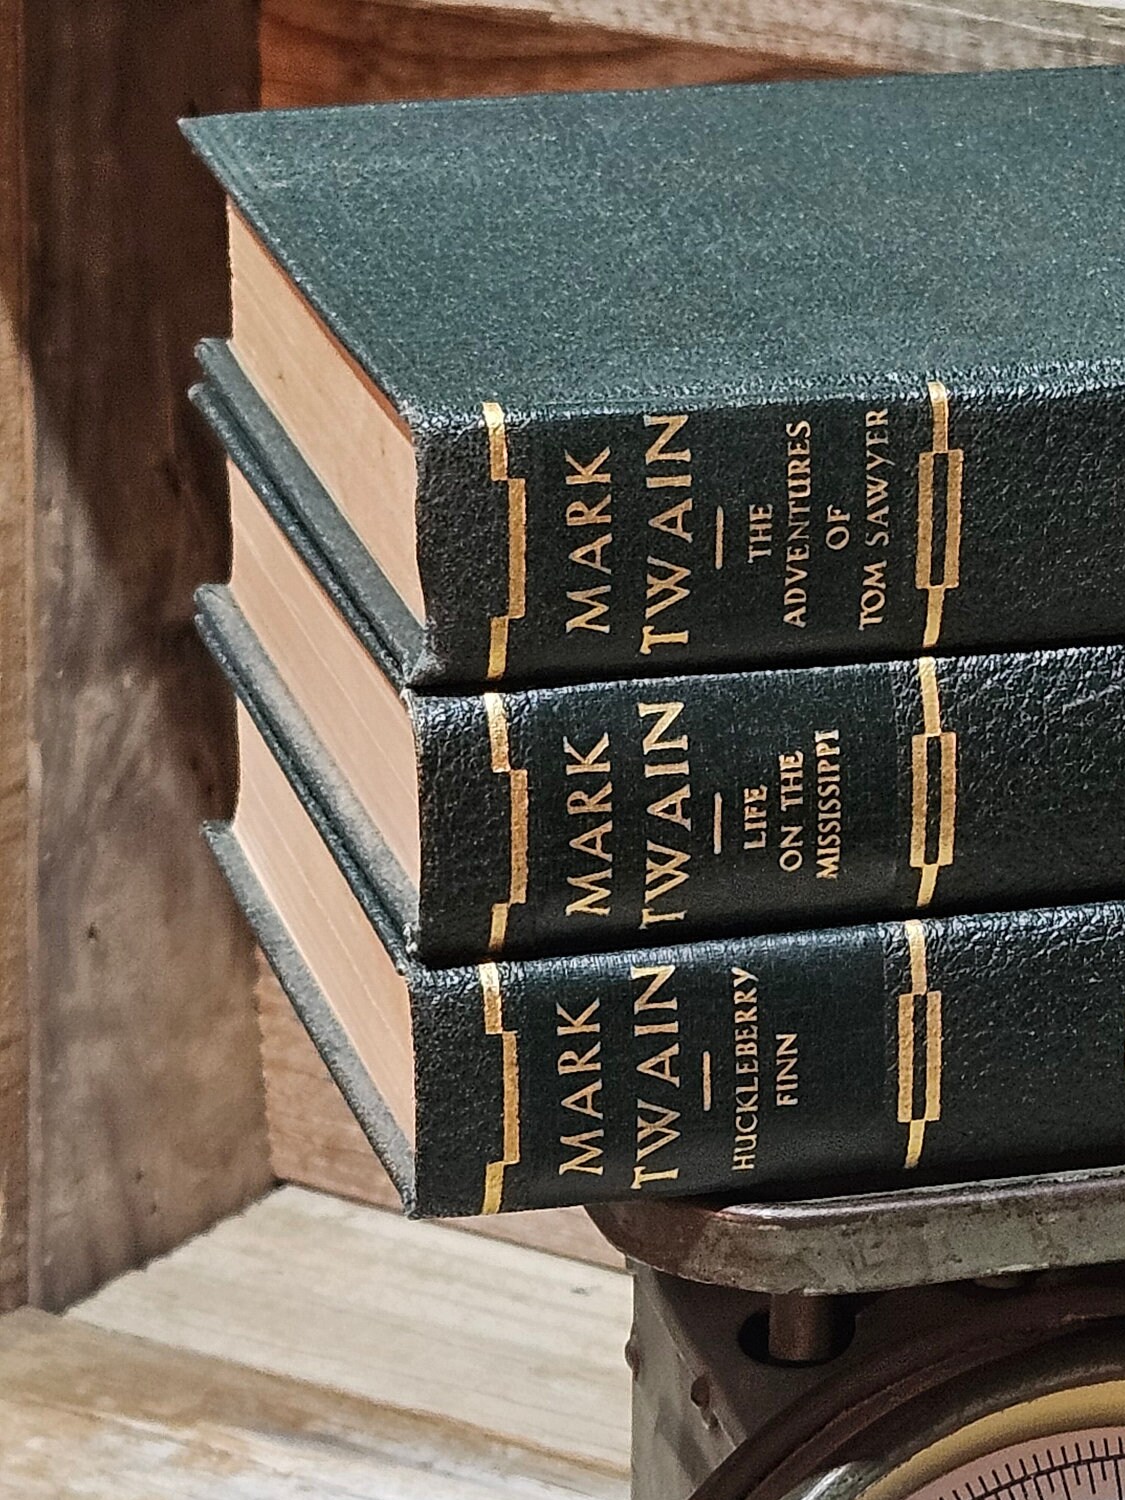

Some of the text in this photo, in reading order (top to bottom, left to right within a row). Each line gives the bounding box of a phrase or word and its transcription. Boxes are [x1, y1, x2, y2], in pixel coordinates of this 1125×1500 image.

[565, 446, 613, 635] MARK
[639, 413, 695, 656] TWAIN
[748, 503, 774, 564] THE
[783, 419, 812, 629] ADVENTURES
[827, 504, 851, 551] OF
[859, 407, 896, 631] TOM SAWYER
[563, 732, 613, 917] MARK
[638, 701, 691, 931] TWAIN
[743, 784, 768, 850] LIFE
[780, 749, 804, 872] ON THE
[816, 729, 841, 880] MISSISSIPPI
[556, 999, 604, 1177] MARK
[630, 964, 682, 1190] TWAIN
[731, 967, 760, 1172] HUCKLEBERRY
[776, 1032, 800, 1107] FINN
